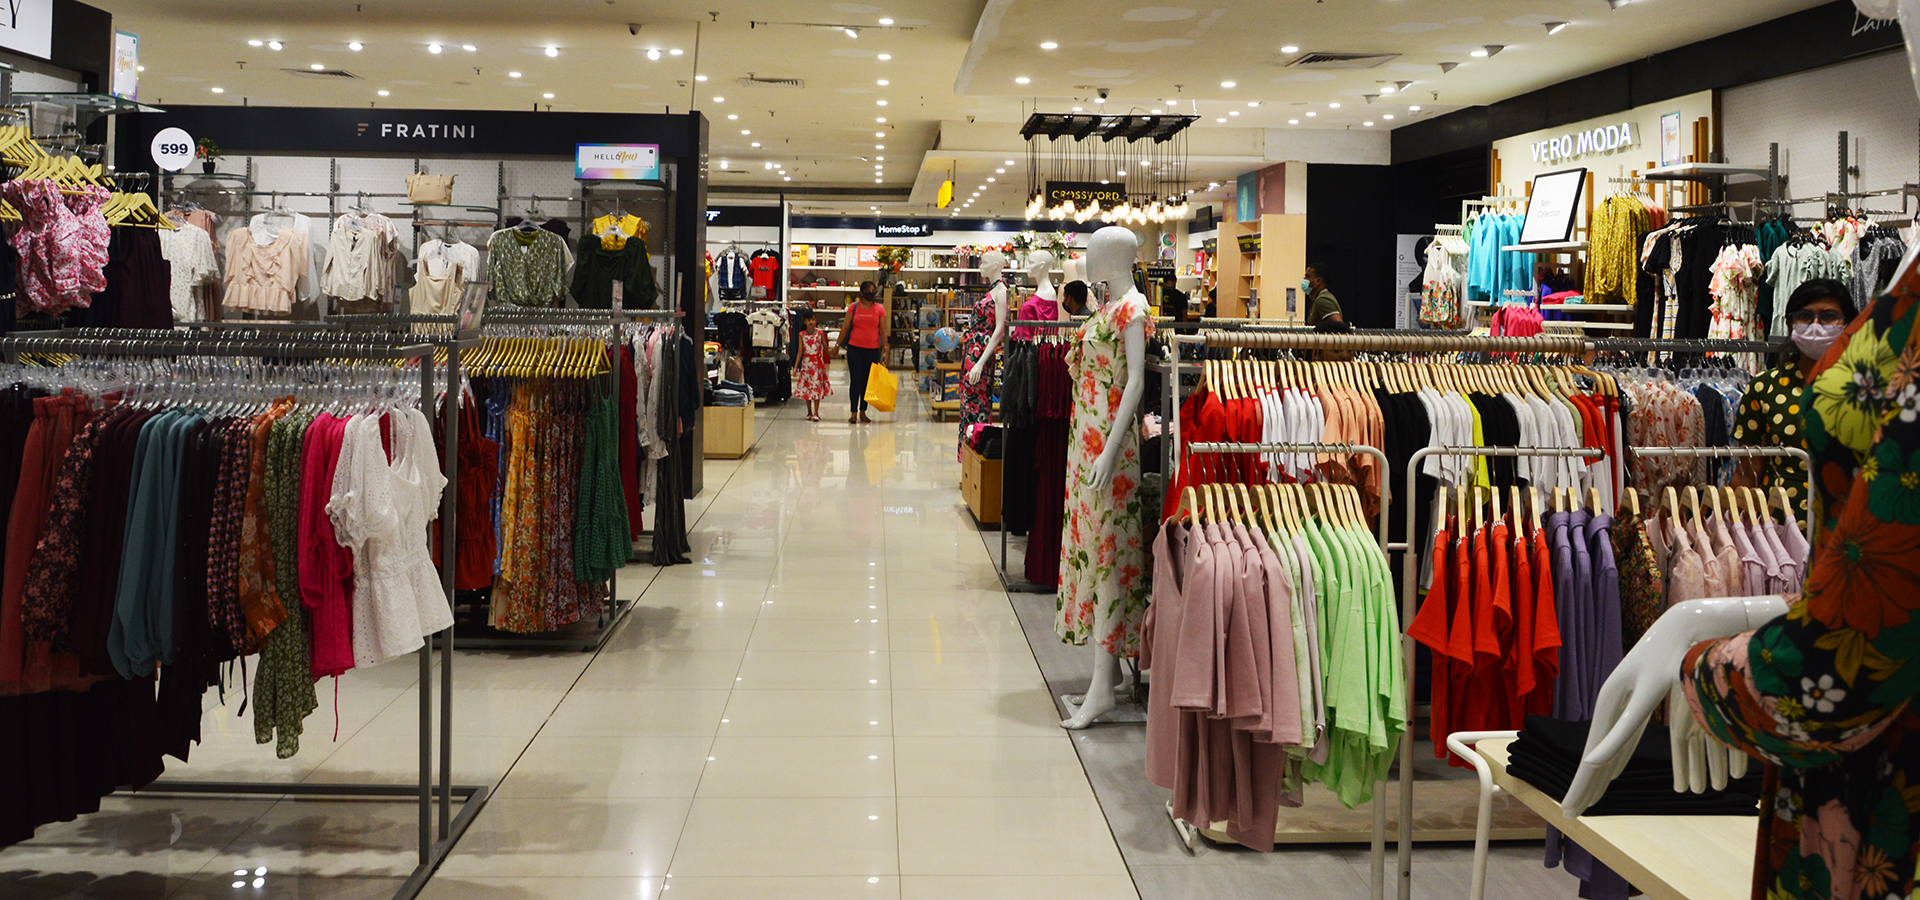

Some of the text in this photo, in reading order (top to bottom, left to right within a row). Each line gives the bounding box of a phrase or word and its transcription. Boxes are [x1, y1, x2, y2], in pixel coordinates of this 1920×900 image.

[0, 0, 21, 29] Y
[119, 49, 133, 57] HELLO
[381, 124, 475, 138] FRATINI
[1531, 122, 1633, 162] VERO MODA
[616, 151, 638, 163] New
[1537, 209, 1561, 218] Collection
[878, 225, 920, 235] HomeStop
